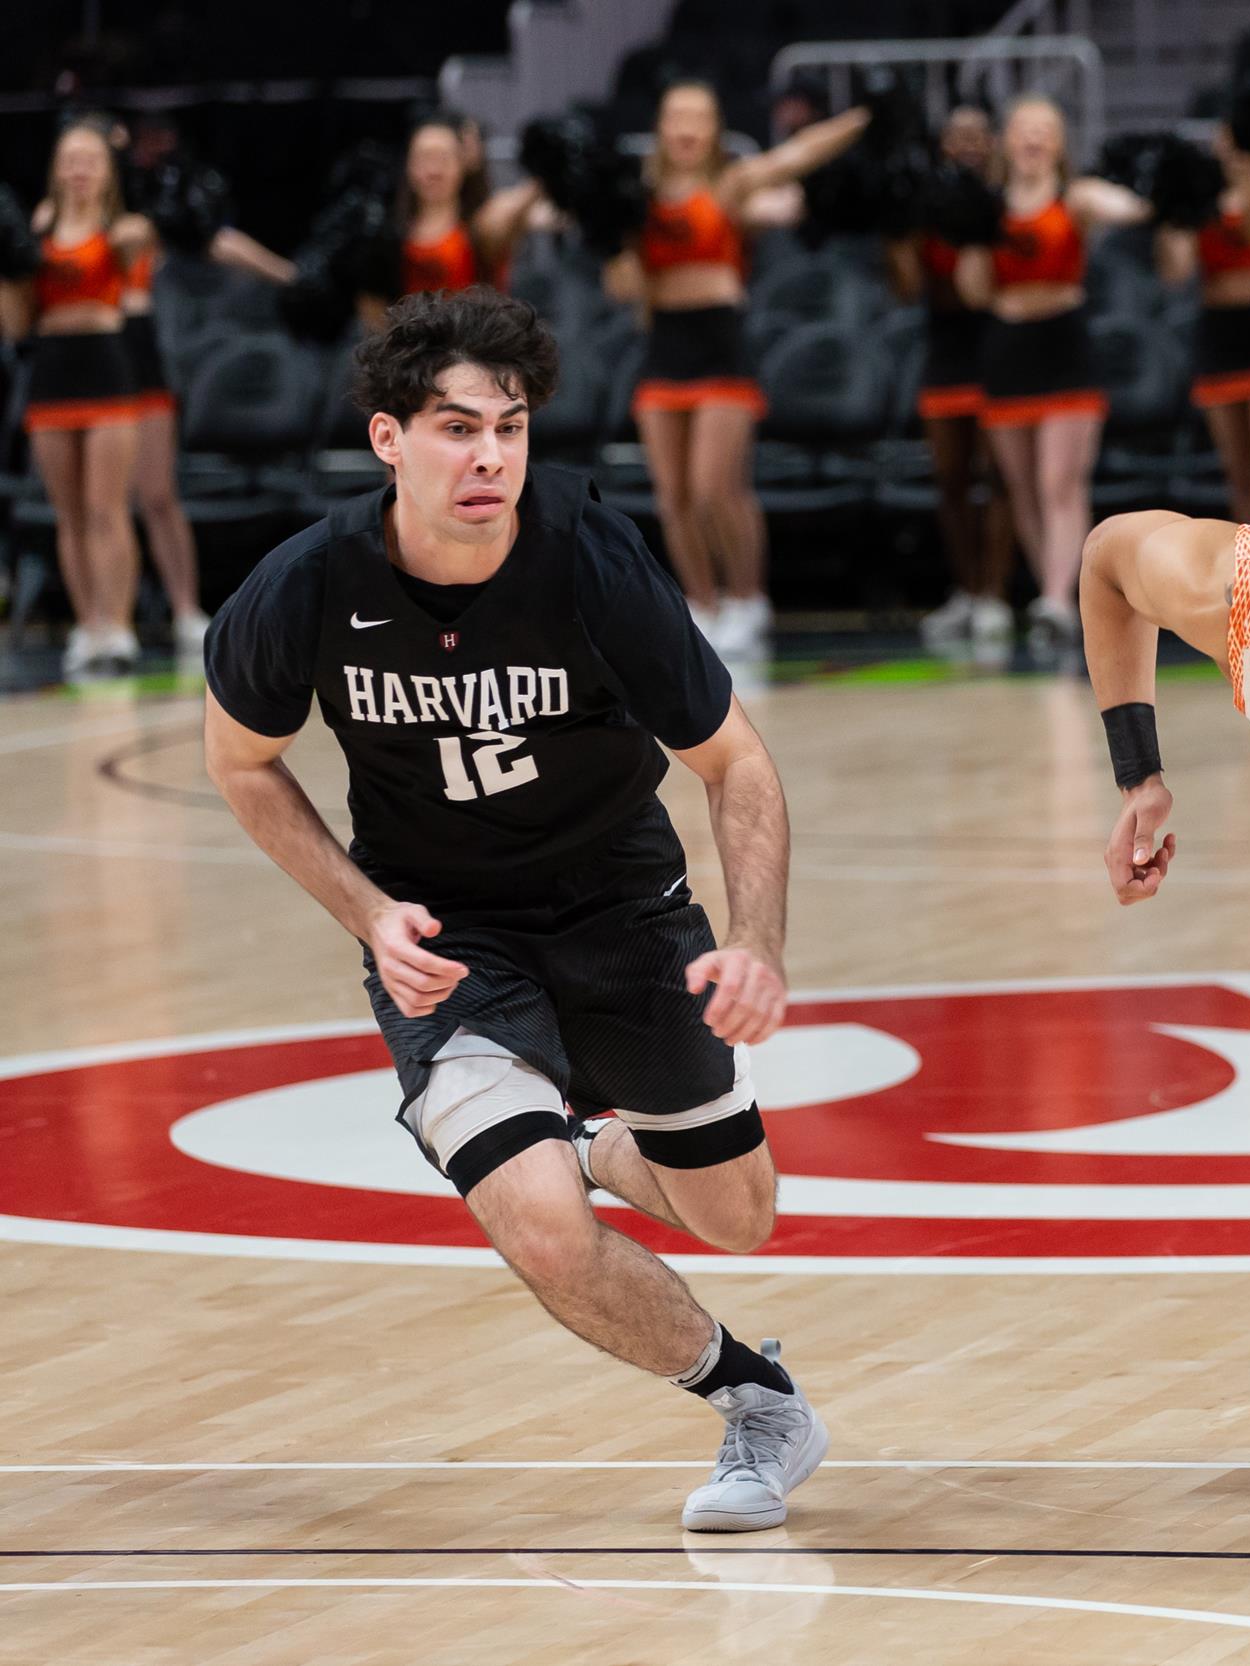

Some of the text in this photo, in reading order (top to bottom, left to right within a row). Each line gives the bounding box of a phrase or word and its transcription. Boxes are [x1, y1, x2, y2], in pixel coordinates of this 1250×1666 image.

[443, 633, 456, 648] H
[343, 664, 570, 731] HARVARD
[432, 730, 540, 801] 12
